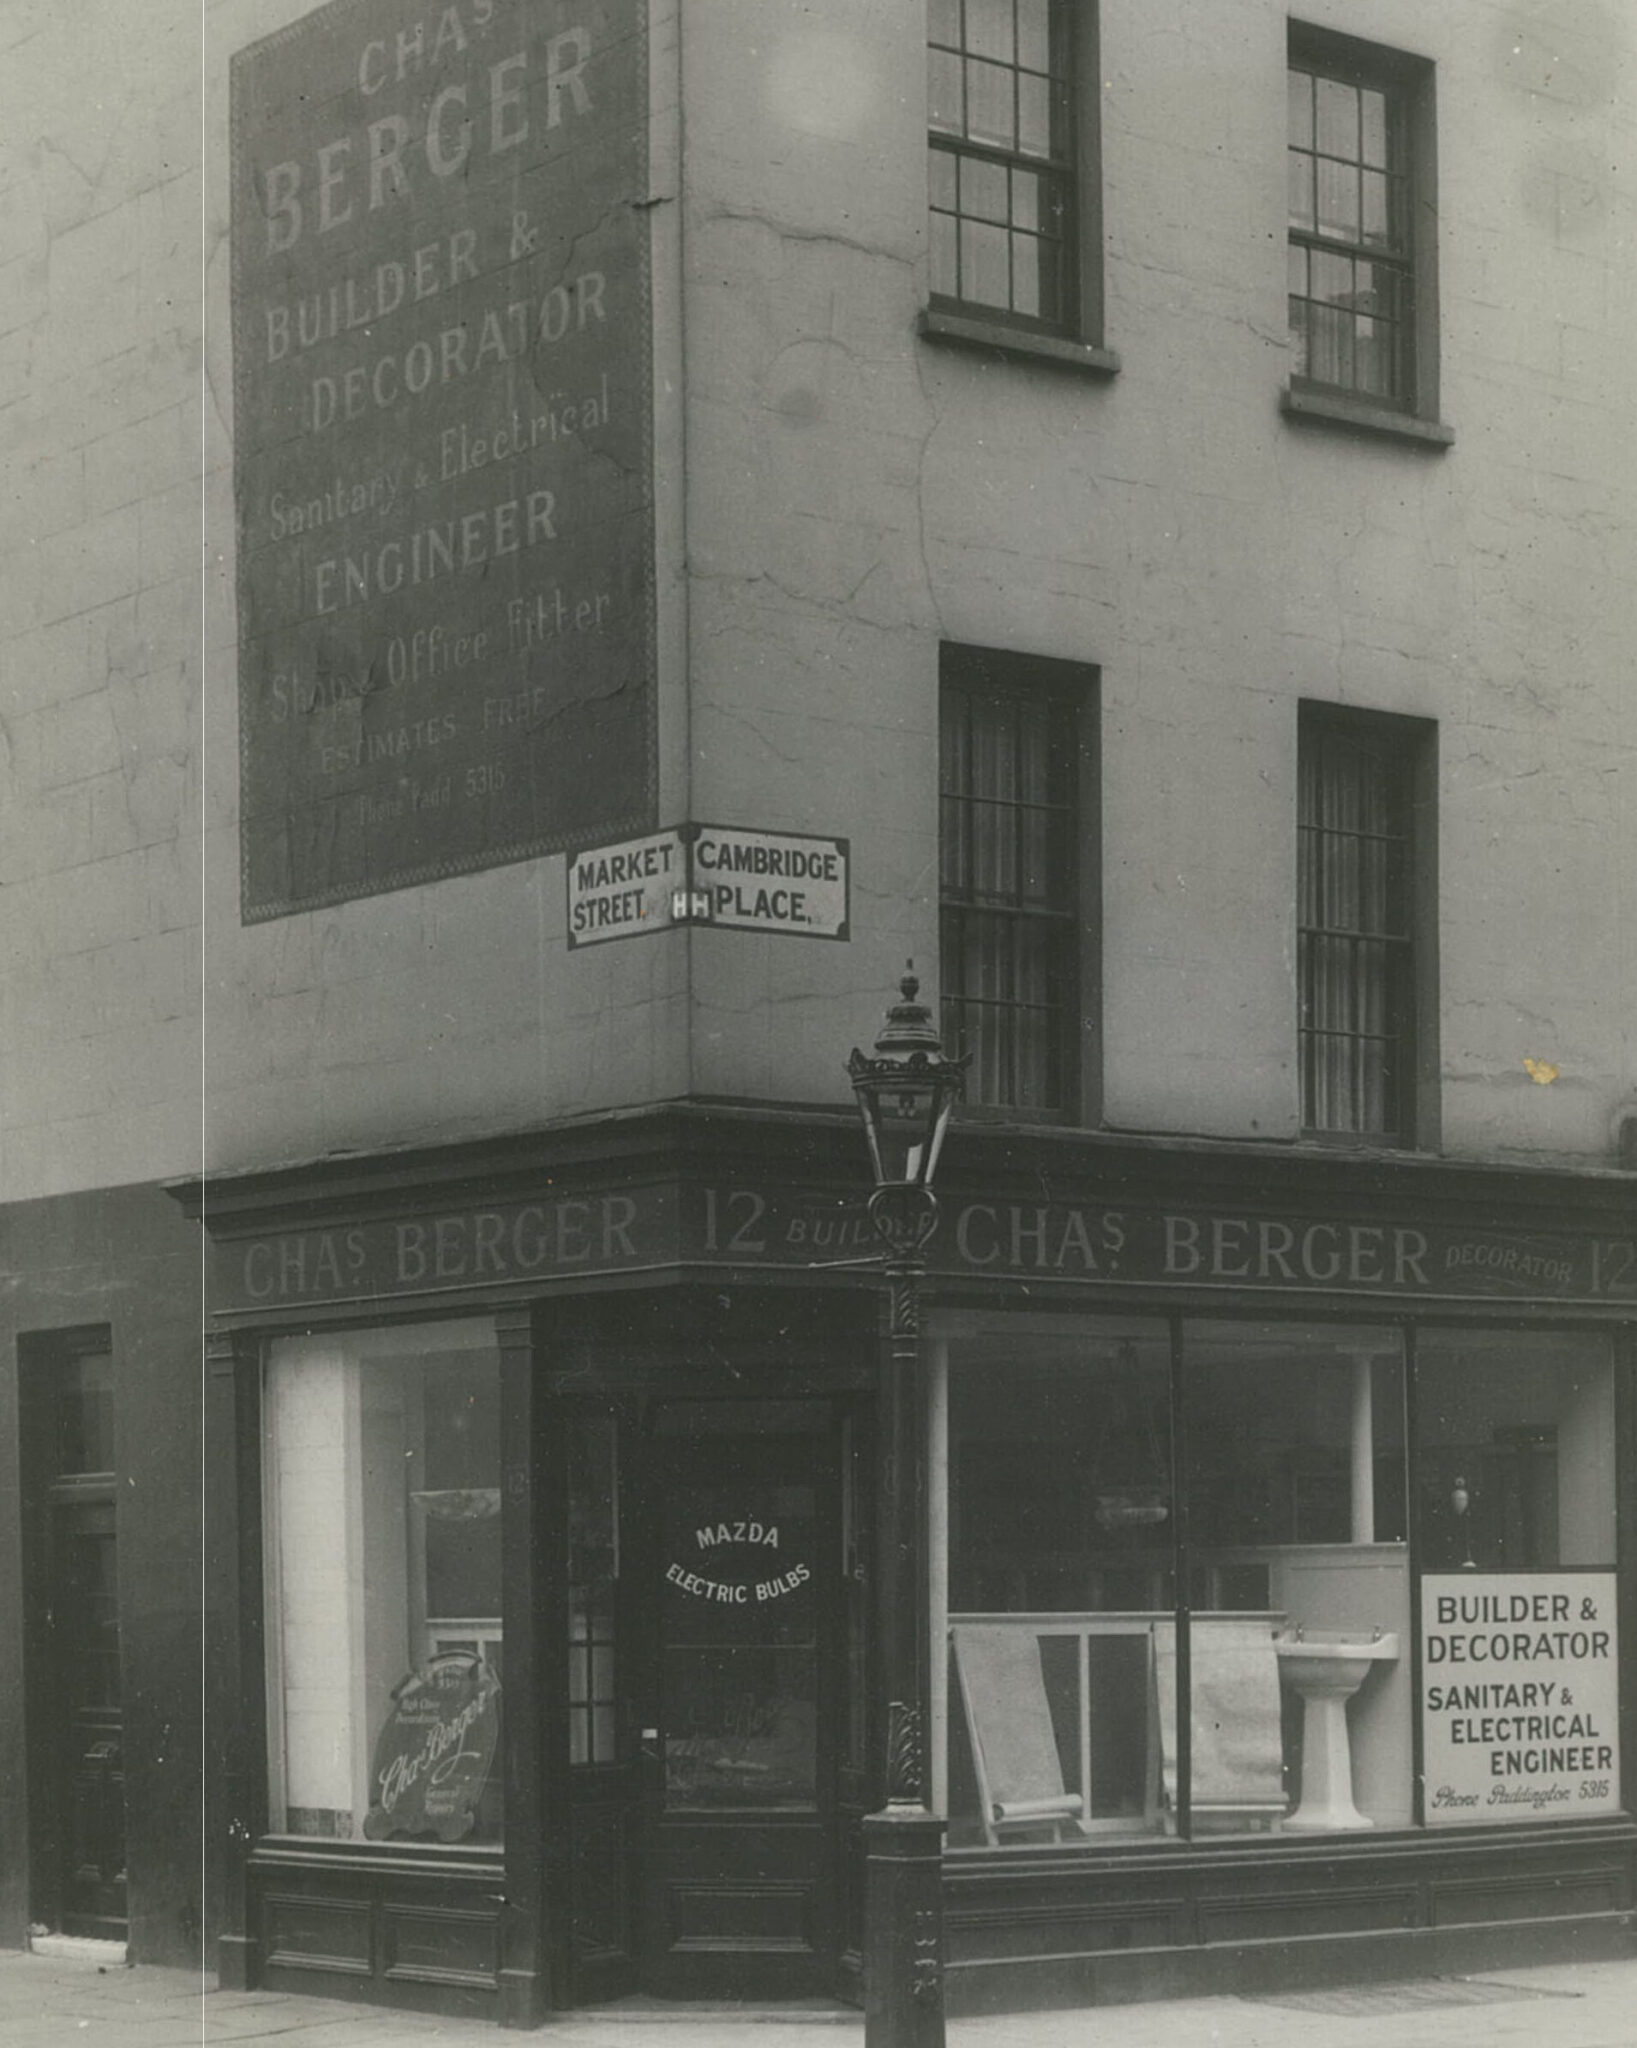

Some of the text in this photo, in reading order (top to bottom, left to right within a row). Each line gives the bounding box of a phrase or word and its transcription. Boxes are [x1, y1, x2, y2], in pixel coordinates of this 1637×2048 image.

[264, 26, 594, 256] BERGER
[266, 210, 539, 363] BUILDER &
[312, 271, 606, 433] DECORATOR
[269, 474, 398, 541] Sanitary
[439, 373, 609, 481] Electrical
[315, 489, 557, 616] ENGINEER
[388, 625, 488, 687] Office
[506, 588, 611, 650] Fitter
[465, 763, 505, 797] 5315
[578, 844, 673, 891] MARKET
[697, 840, 838, 881] CAMBRIDGE
[396, 1196, 637, 1282] BERGER
[704, 1188, 766, 1252] 12
[1162, 1216, 1430, 1285] BERGER
[1445, 1244, 1573, 1283] DECORATOR
[1587, 1240, 1636, 1294] 12
[696, 1522, 779, 1549] MAZDA
[665, 1563, 811, 1603] ELECTRIC BULBS
[1437, 1595, 1598, 1624] BUILDER &
[1428, 1632, 1610, 1663] DECORATOR
[1427, 1682, 1573, 1711] SANITARY &
[1451, 1714, 1599, 1744] ELECTRICAL
[1491, 1746, 1613, 1776] ENGINEER
[1432, 1780, 1610, 1809] Phone Paddington 5315
